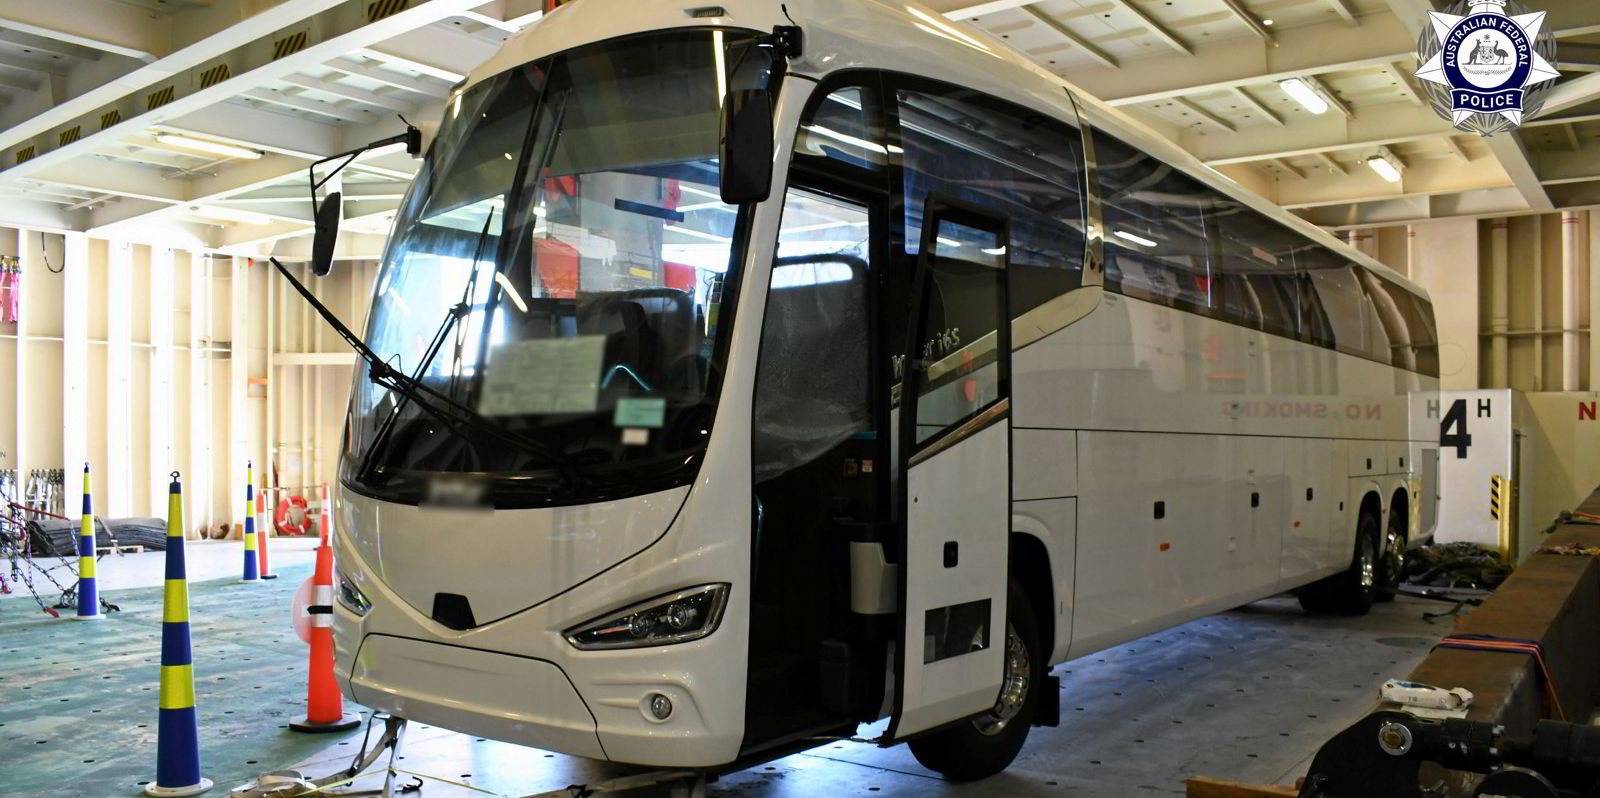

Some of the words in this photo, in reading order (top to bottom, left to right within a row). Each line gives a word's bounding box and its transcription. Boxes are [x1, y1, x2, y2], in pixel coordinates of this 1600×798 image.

[1477, 398, 1491, 417] H
[1578, 401, 1596, 420] N
[1440, 399, 1472, 458] 4
